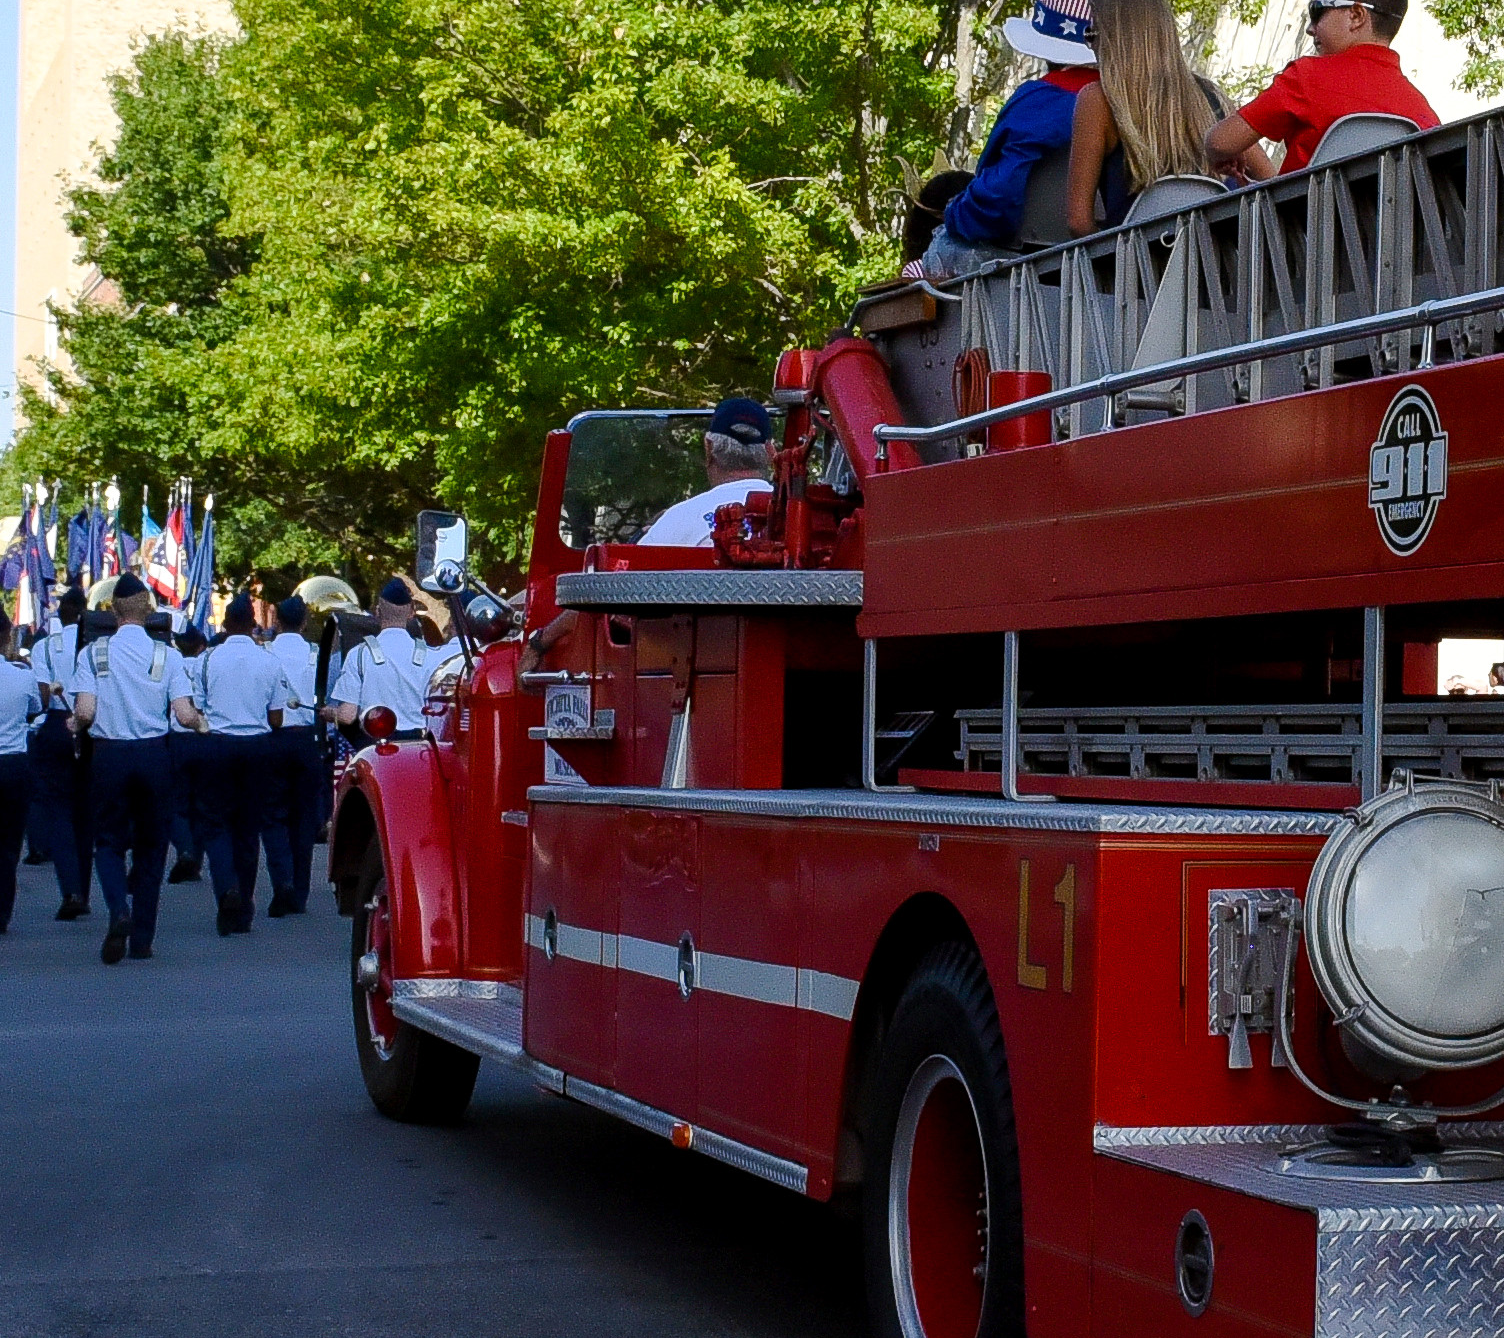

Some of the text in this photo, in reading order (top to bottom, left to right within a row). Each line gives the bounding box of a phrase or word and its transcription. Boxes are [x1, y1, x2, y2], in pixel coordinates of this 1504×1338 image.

[1397, 413, 1422, 439] CALL
[1371, 438, 1445, 502] 911
[1017, 858, 1076, 993] L1
